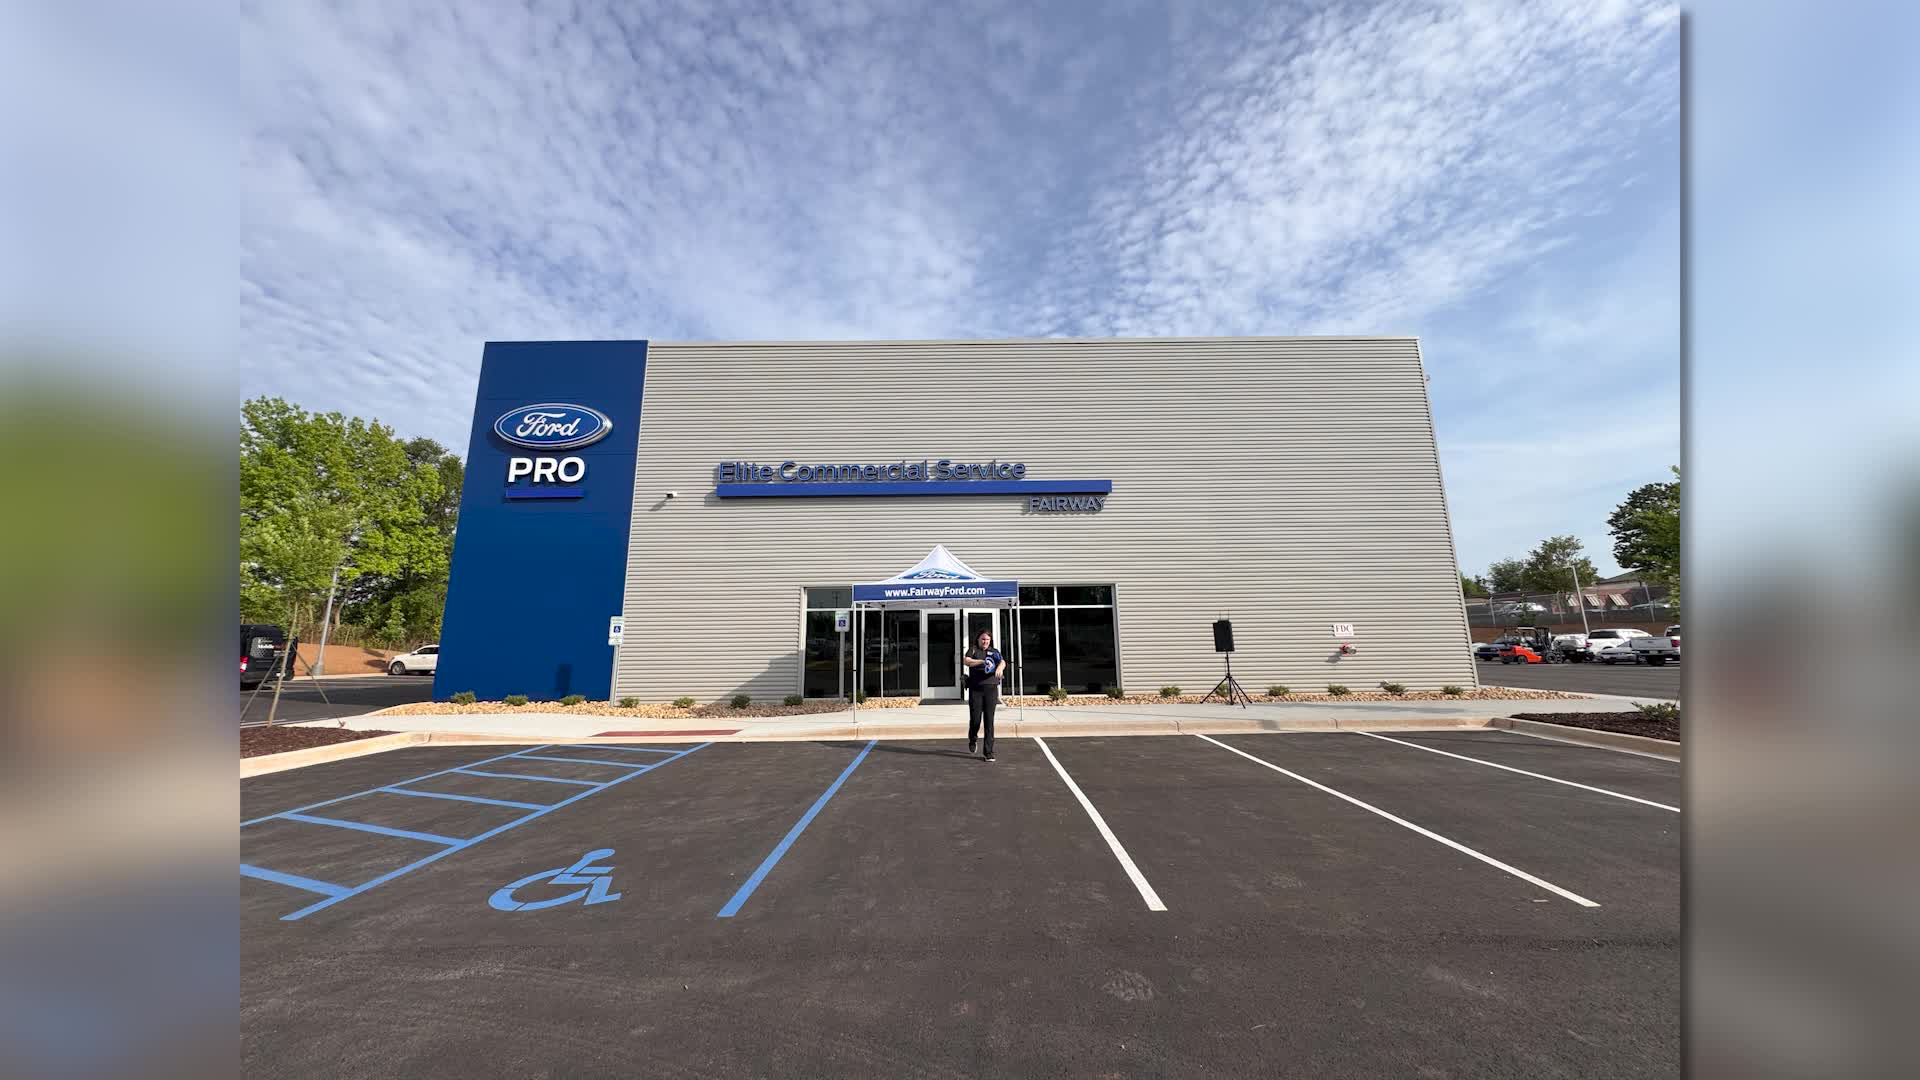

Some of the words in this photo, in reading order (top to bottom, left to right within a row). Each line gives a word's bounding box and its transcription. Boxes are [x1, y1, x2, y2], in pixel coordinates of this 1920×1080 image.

[516, 412, 581, 437] Ford
[507, 457, 585, 483] PRO
[719, 462, 773, 480] Elite
[779, 460, 928, 481] Commercial
[936, 459, 1026, 479] Service
[1029, 496, 1105, 511] FAIRWAY
[885, 586, 985, 597] www.FairwayFord.com
